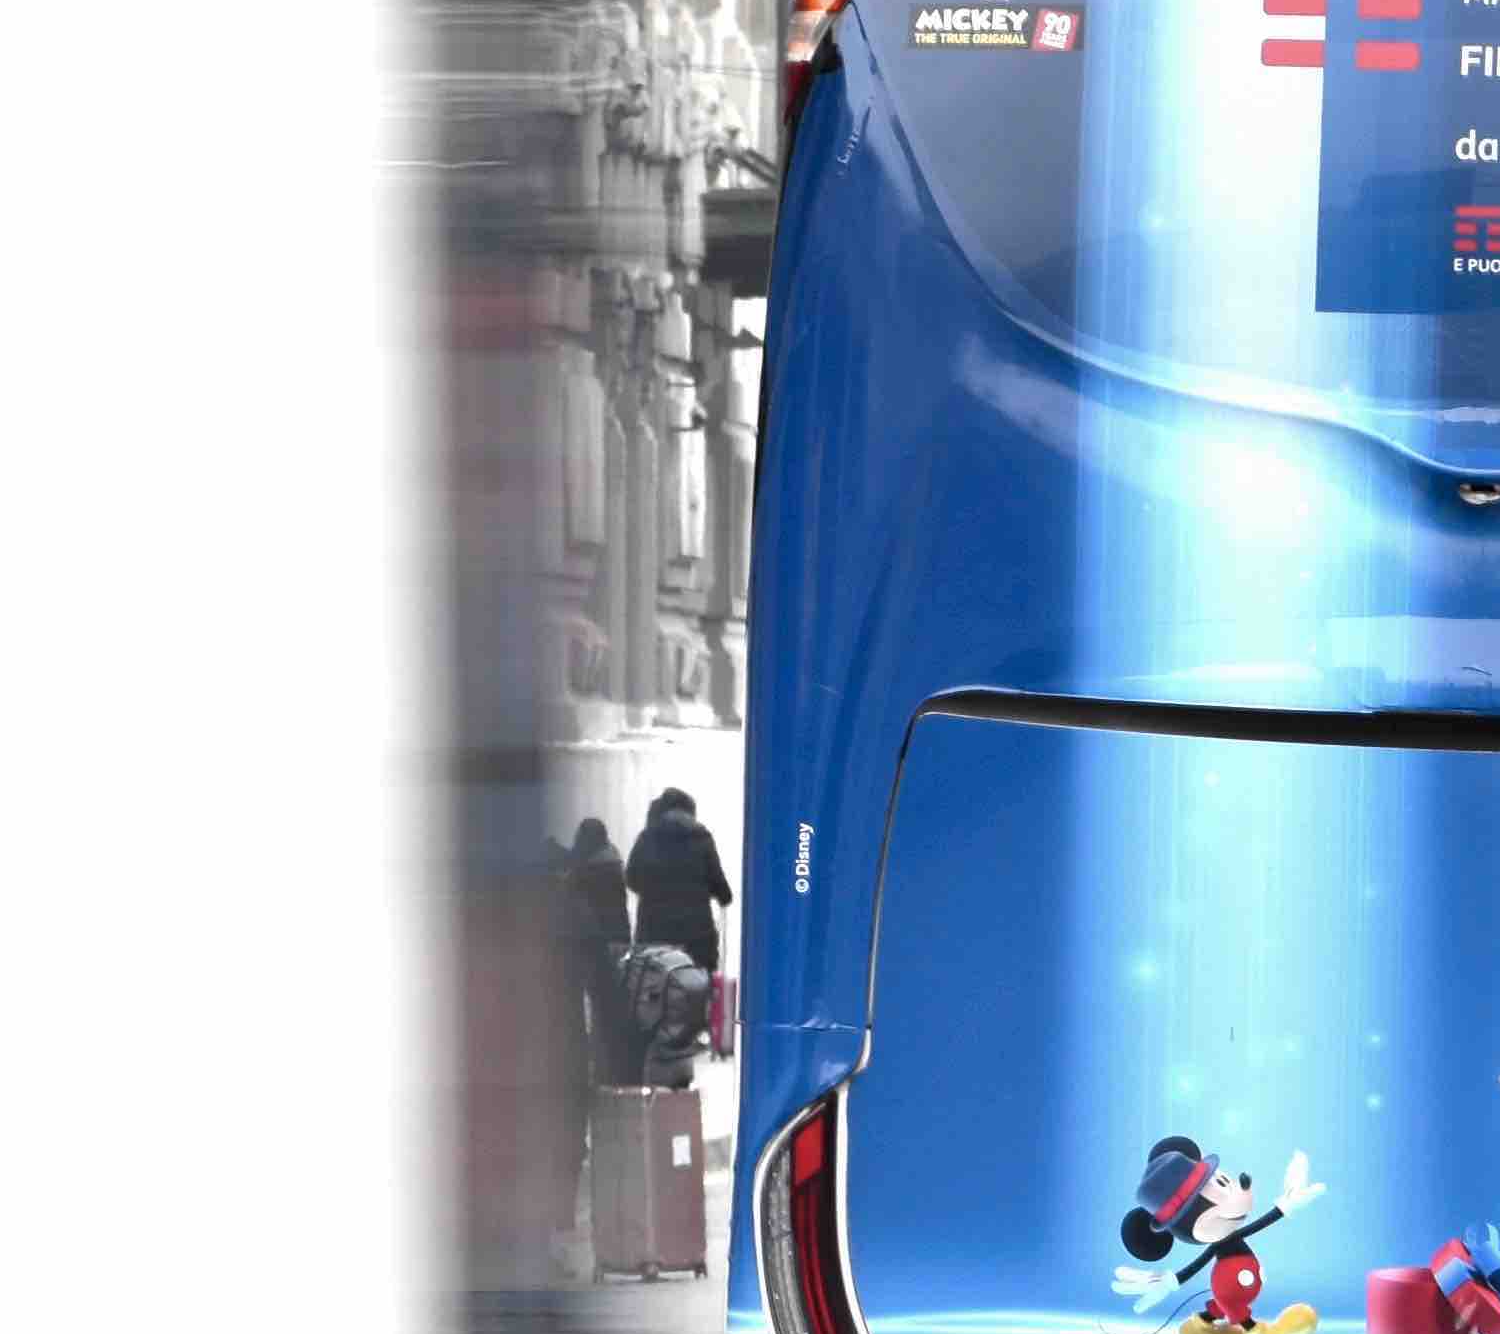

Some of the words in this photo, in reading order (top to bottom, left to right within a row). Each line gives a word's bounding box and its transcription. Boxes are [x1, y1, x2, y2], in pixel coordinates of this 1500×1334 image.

[915, 8, 1029, 31] MICKEY
[1043, 12, 1071, 34] 90
[914, 32, 937, 44] THE
[940, 32, 971, 44] TRUE
[973, 32, 1027, 44] ORIGINAL
[1455, 130, 1499, 162] da
[1453, 259, 1463, 272] E
